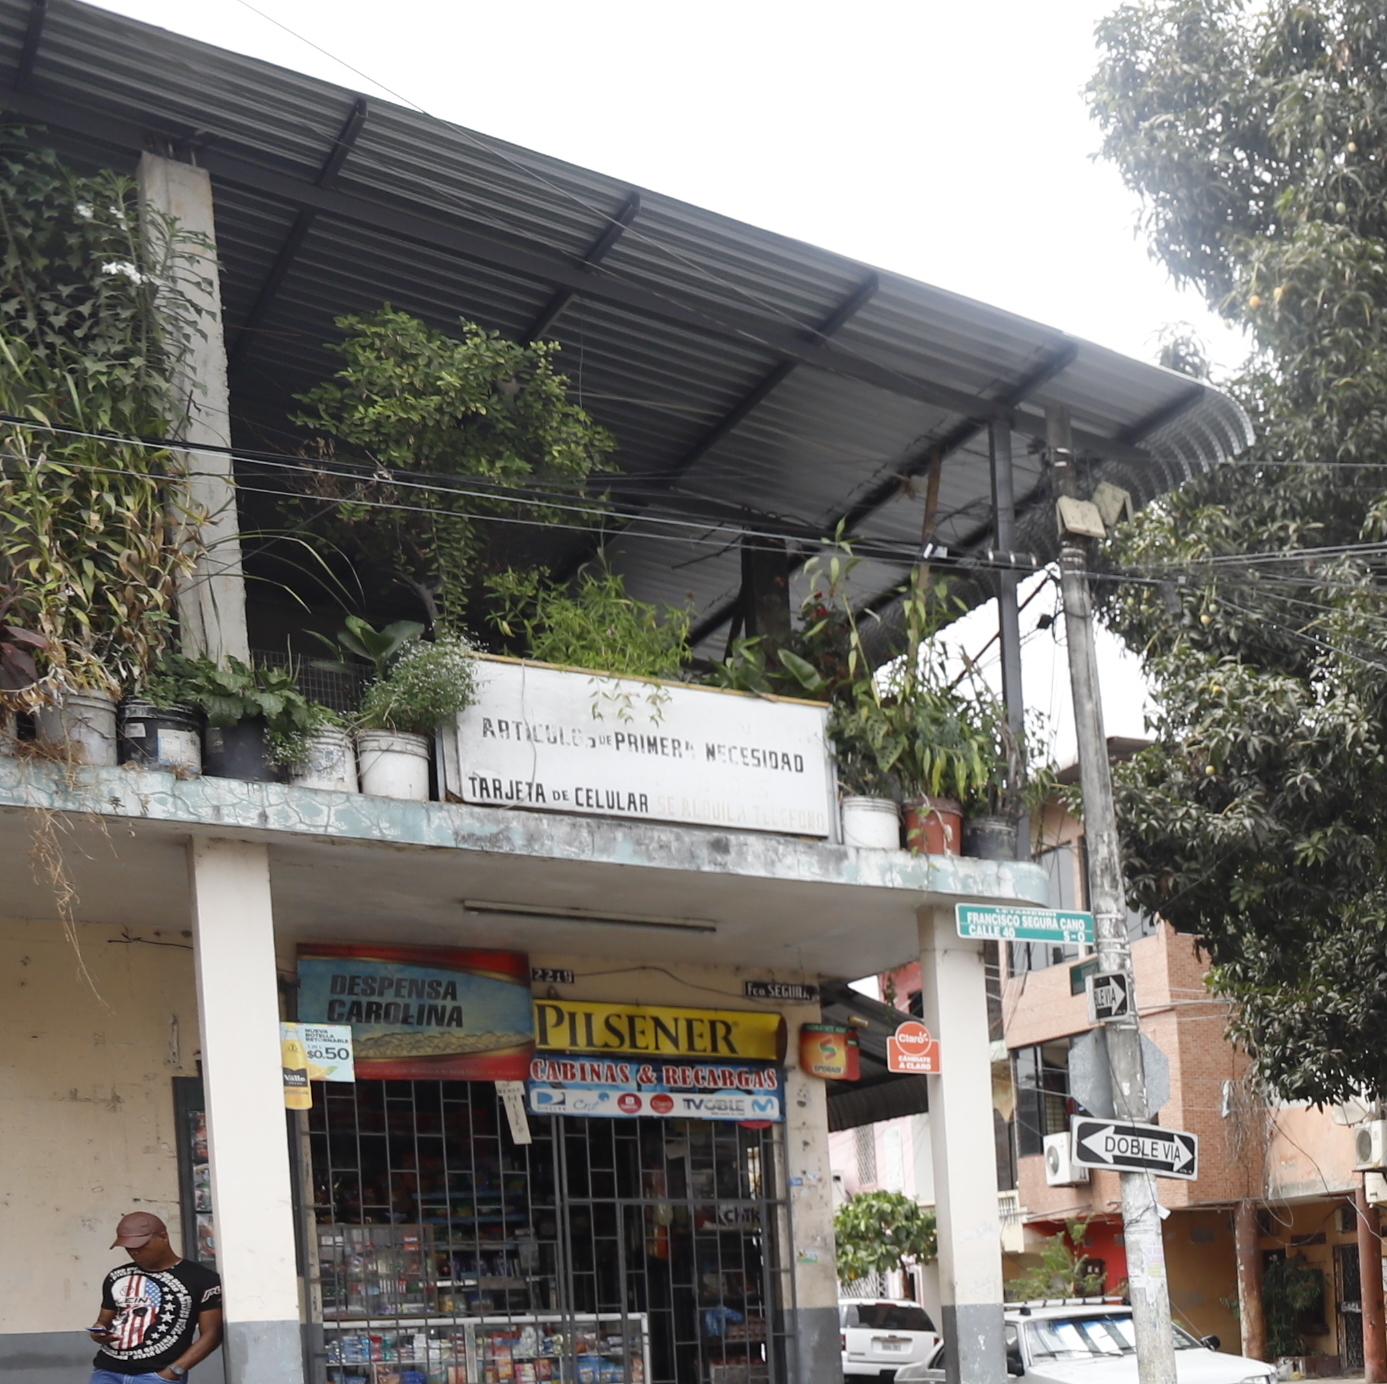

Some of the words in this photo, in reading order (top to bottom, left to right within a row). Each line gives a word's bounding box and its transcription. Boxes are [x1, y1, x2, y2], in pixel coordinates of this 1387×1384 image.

[705, 742, 804, 773] NECESIDAD
[468, 776, 547, 803] TARJETA
[552, 789, 569, 801] DE
[574, 787, 649, 813] CELULAR
[967, 912, 1020, 927] FRANCISCO
[1022, 915, 1058, 930] SEGURA
[1060, 918, 1085, 931] CANO
[969, 924, 1000, 938] CALLE
[1002, 927, 1016, 938] 40
[330, 974, 458, 1001] DESPENSA
[327, 999, 464, 1028] CAROLINA
[536, 1004, 738, 1054] PILSENER
[899, 1032, 925, 1044] Claro
[307, 1047, 350, 1061] $0.50
[284, 1074, 305, 1083] Valle
[530, 1059, 630, 1083] CABINAS
[637, 1063, 657, 1084] &
[662, 1065, 778, 1090] RECARGAS
[1105, 1136, 1159, 1158] DOBLE
[1163, 1143, 1181, 1162] VIA
